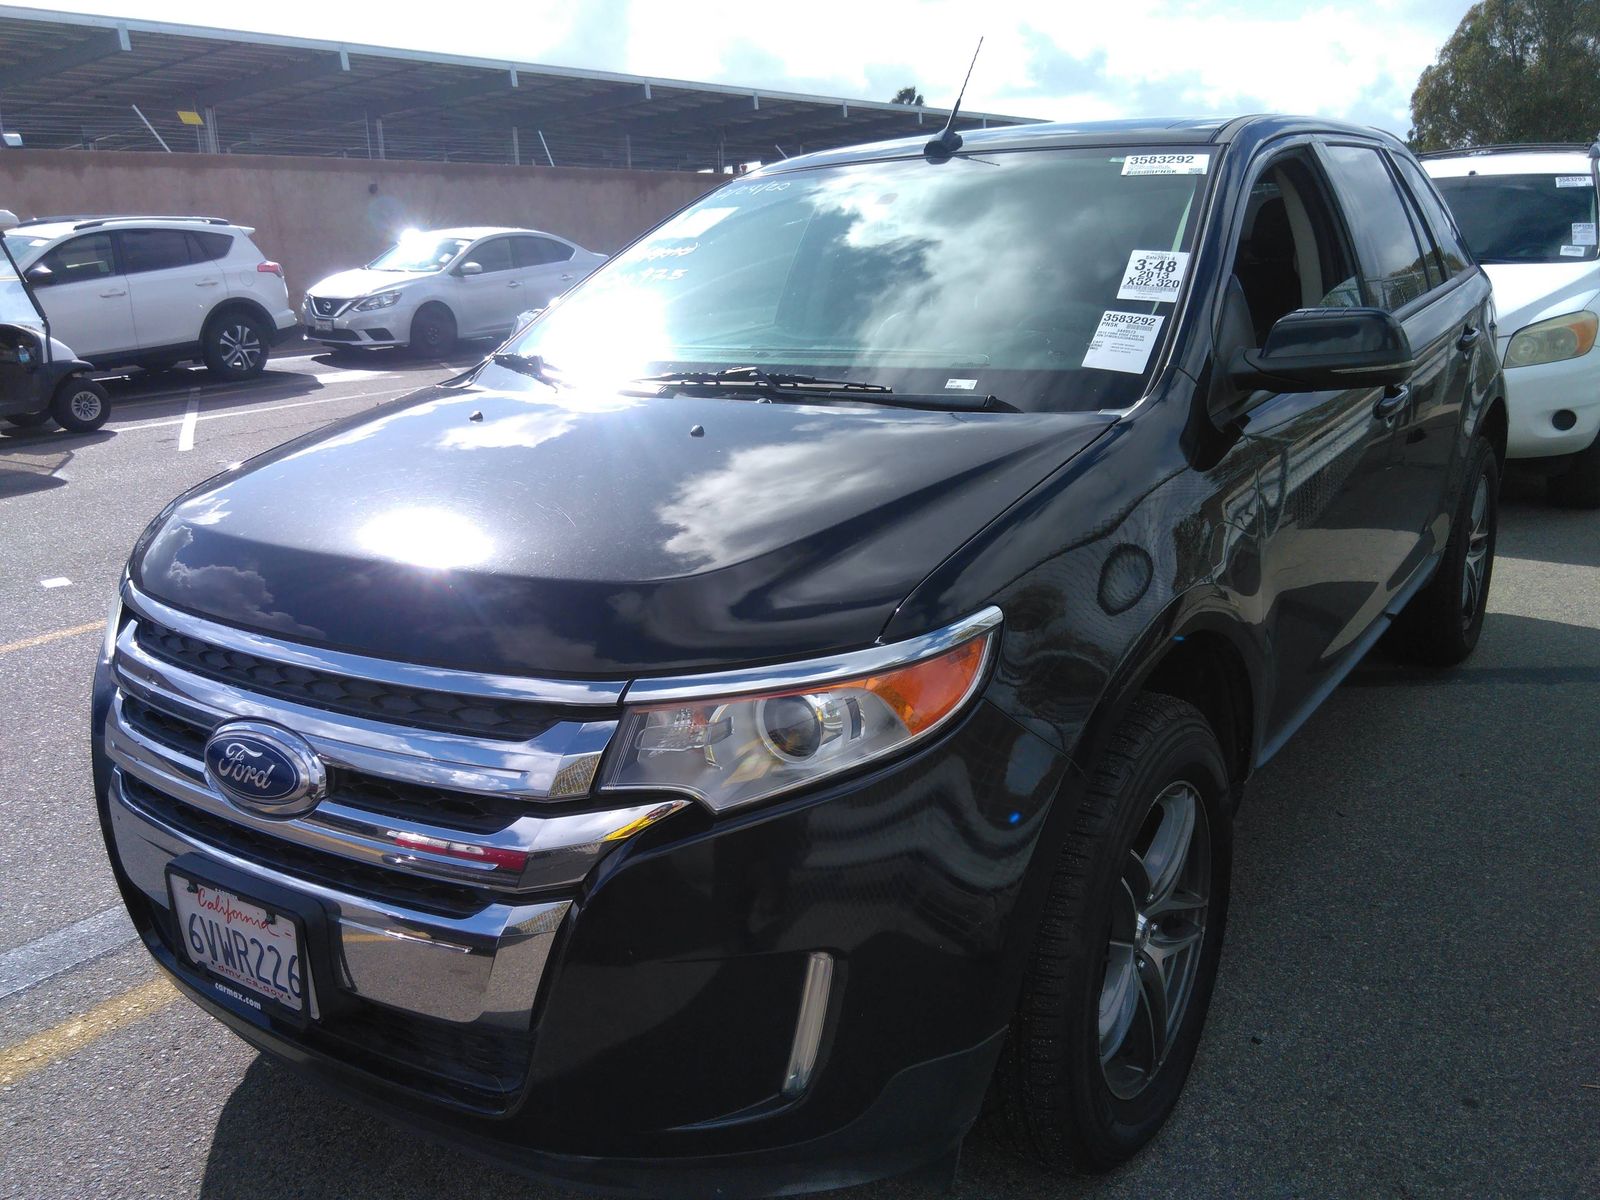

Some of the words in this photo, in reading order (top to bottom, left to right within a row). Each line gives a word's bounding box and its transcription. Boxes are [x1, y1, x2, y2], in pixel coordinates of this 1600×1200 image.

[1130, 155, 1195, 165] 3583292
[1134, 259, 1177, 272] 3:48
[1138, 271, 1170, 279] 2013
[1103, 313, 1156, 326] 3583292
[218, 742, 276, 789] Ford
[197, 887, 281, 938] California
[188, 912, 301, 999] 6VWR226
[218, 964, 284, 999] dmv.ca.gov
[214, 982, 262, 1011] carmax.com
